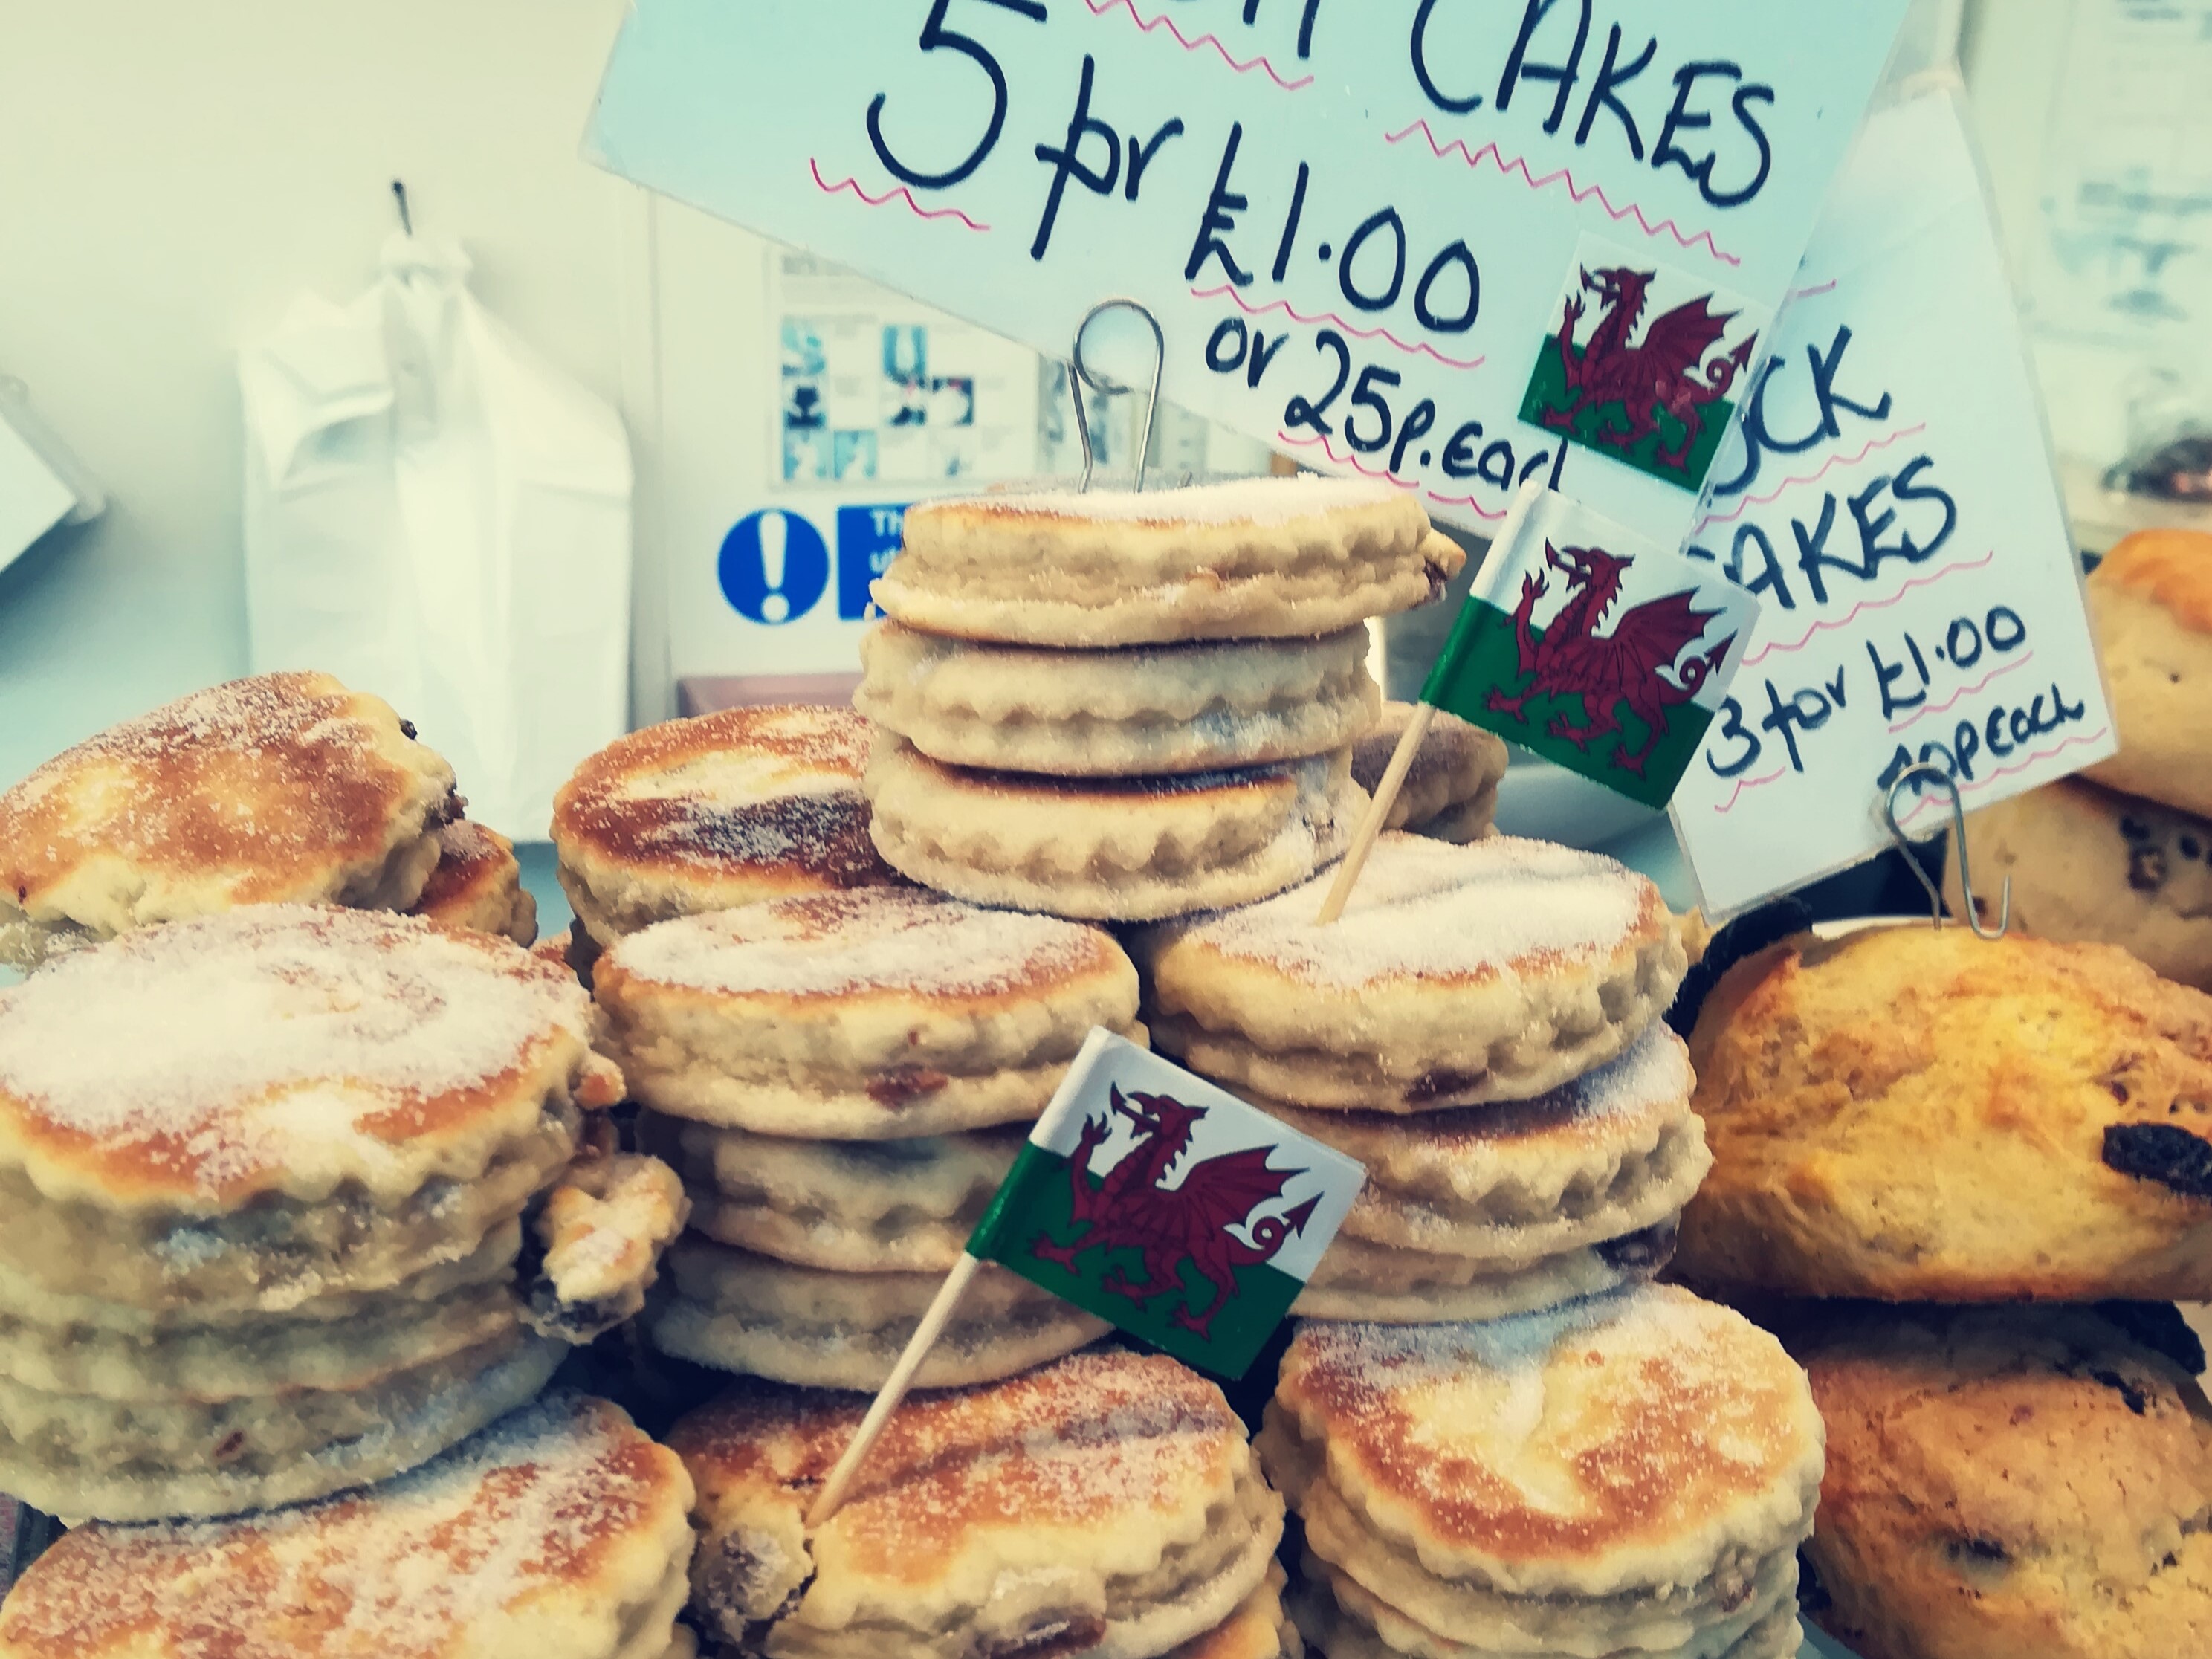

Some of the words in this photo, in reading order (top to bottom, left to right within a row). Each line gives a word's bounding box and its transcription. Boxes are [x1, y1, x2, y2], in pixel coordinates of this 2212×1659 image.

[867, 0, 1048, 190] 5
[1184, 120, 1480, 334] £1.00
[1410, 0, 1774, 207] CAKES
[1686, 454, 1957, 609] AKES
[1706, 694, 1762, 778] 3
[1866, 606, 2027, 721] £1.00
